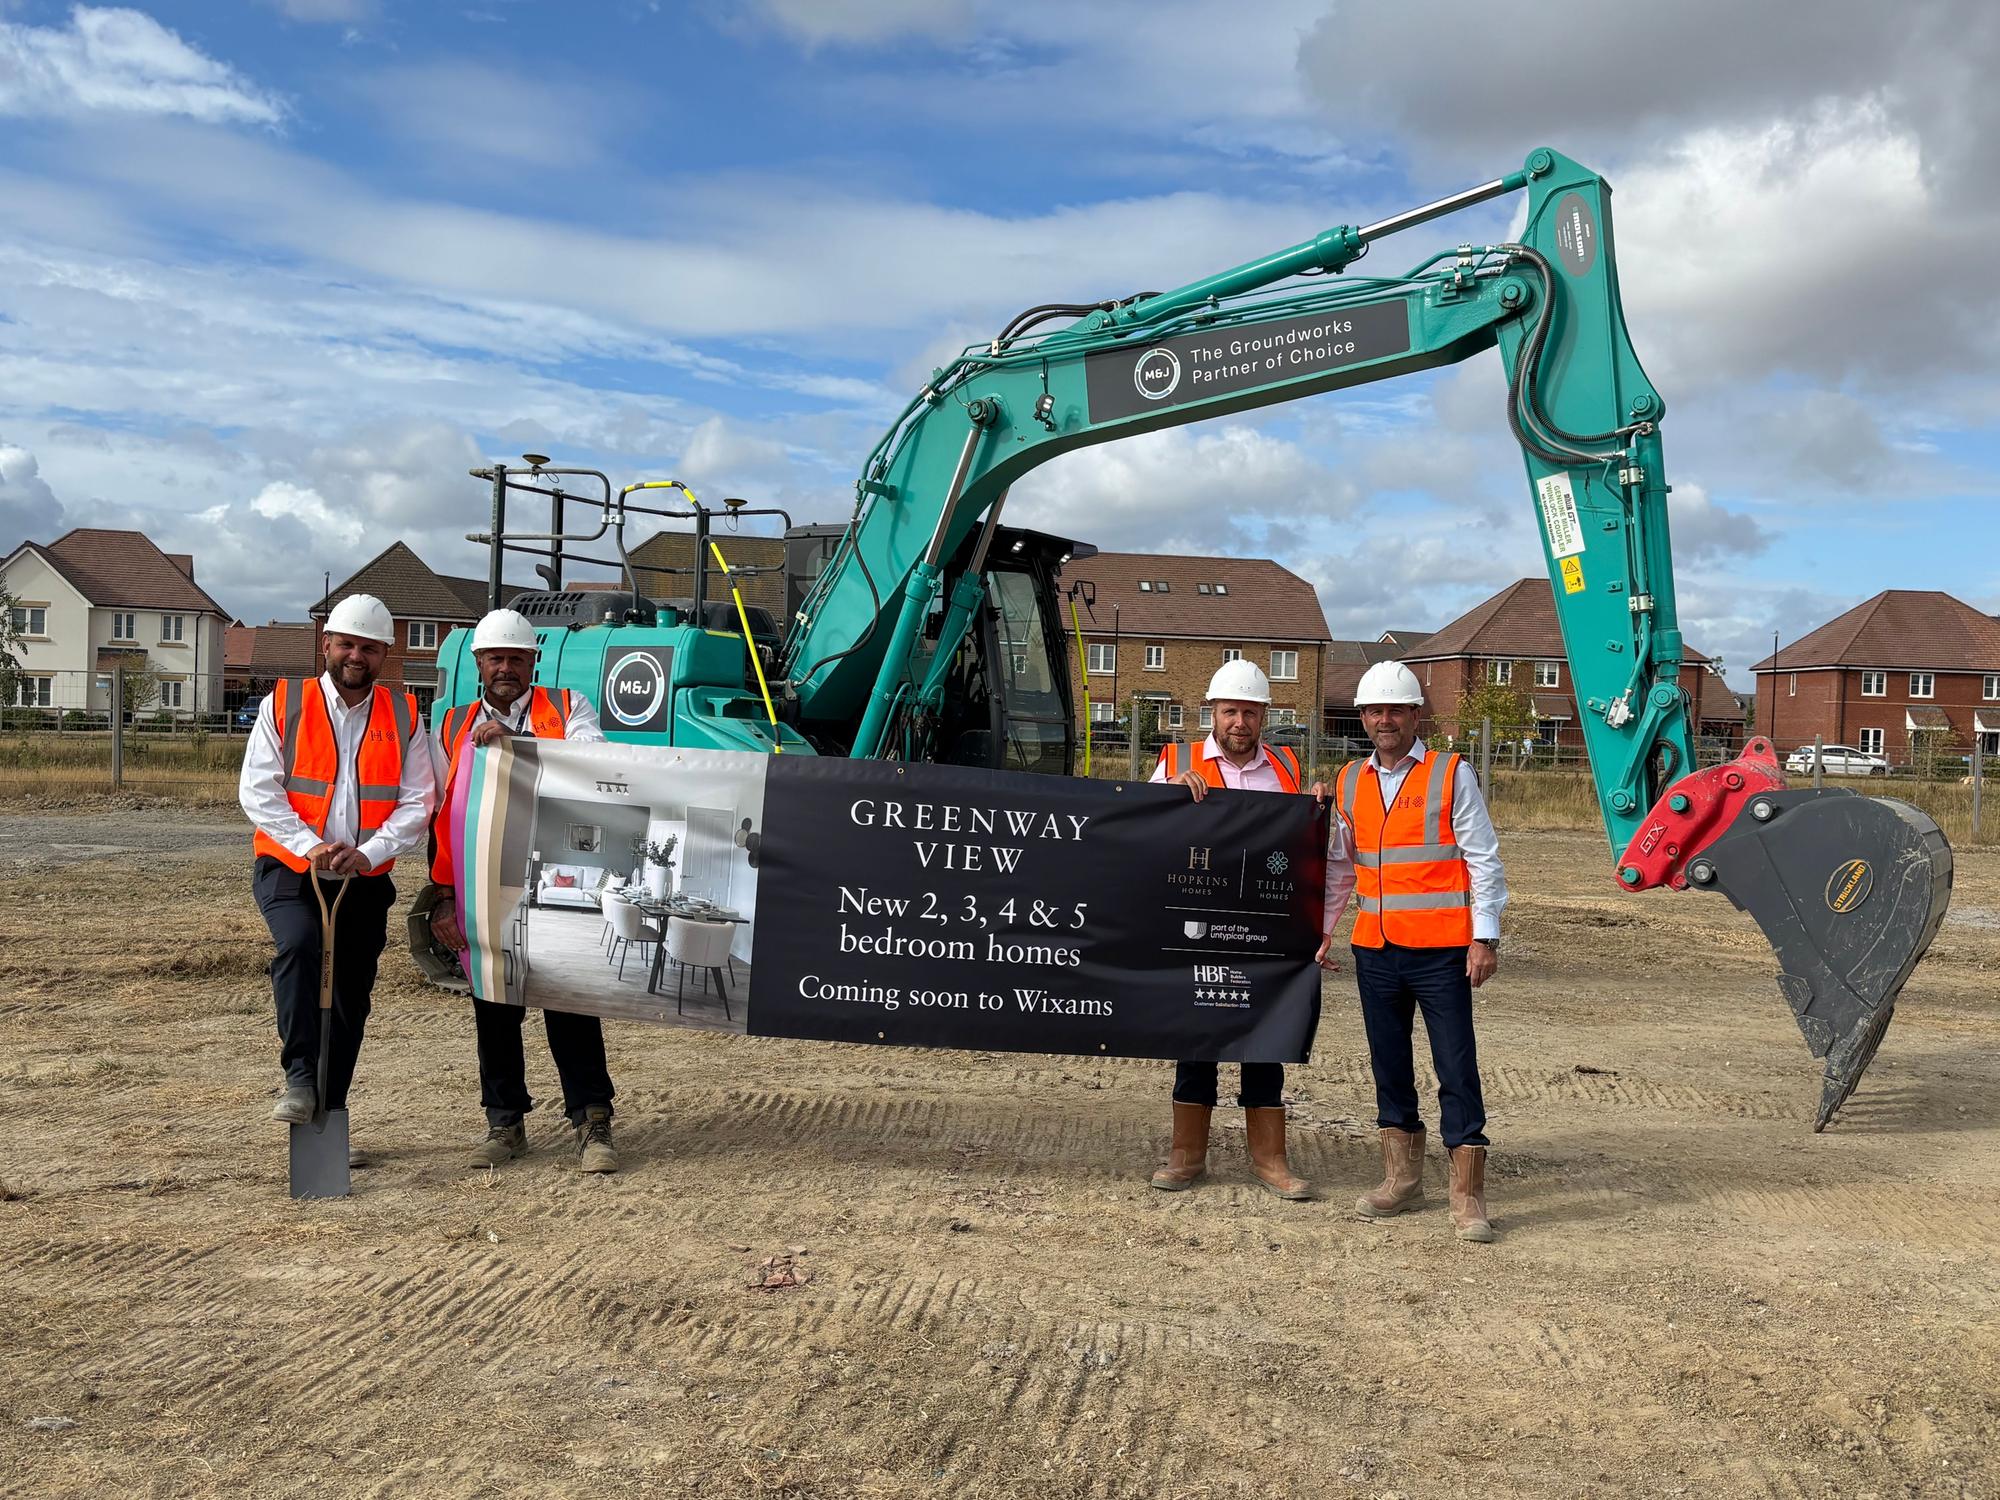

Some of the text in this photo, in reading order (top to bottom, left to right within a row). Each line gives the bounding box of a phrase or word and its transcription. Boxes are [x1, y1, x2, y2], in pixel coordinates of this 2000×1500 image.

[1190, 320, 1353, 364] The Groundworks
[1145, 366, 1170, 381] M&J
[1192, 341, 1355, 384] Partner of Choice
[1545, 481, 1566, 553] TWINLOCK COUPLER
[1553, 485, 1573, 545] GENUINE MILLER
[619, 680, 651, 695] M&J
[850, 799, 1090, 841] GREENWAY
[1639, 820, 1667, 855] GTX
[913, 840, 1025, 874] VIEW
[1167, 873, 1229, 888] HOPKINS
[1181, 887, 1213, 896] HOMES
[1256, 879, 1295, 892] TILIA
[1259, 892, 1290, 901] HOMES
[1833, 864, 1867, 909] STRICKLAND
[837, 886, 1088, 929] New 2, 3, 4 & 5
[839, 923, 1081, 967] bedroom homes
[1210, 931, 1268, 943] untypical group
[1211, 924, 1250, 933] part of the
[1193, 965, 1230, 983] HBF
[799, 975, 1114, 1017] Coming soon to Wixams
